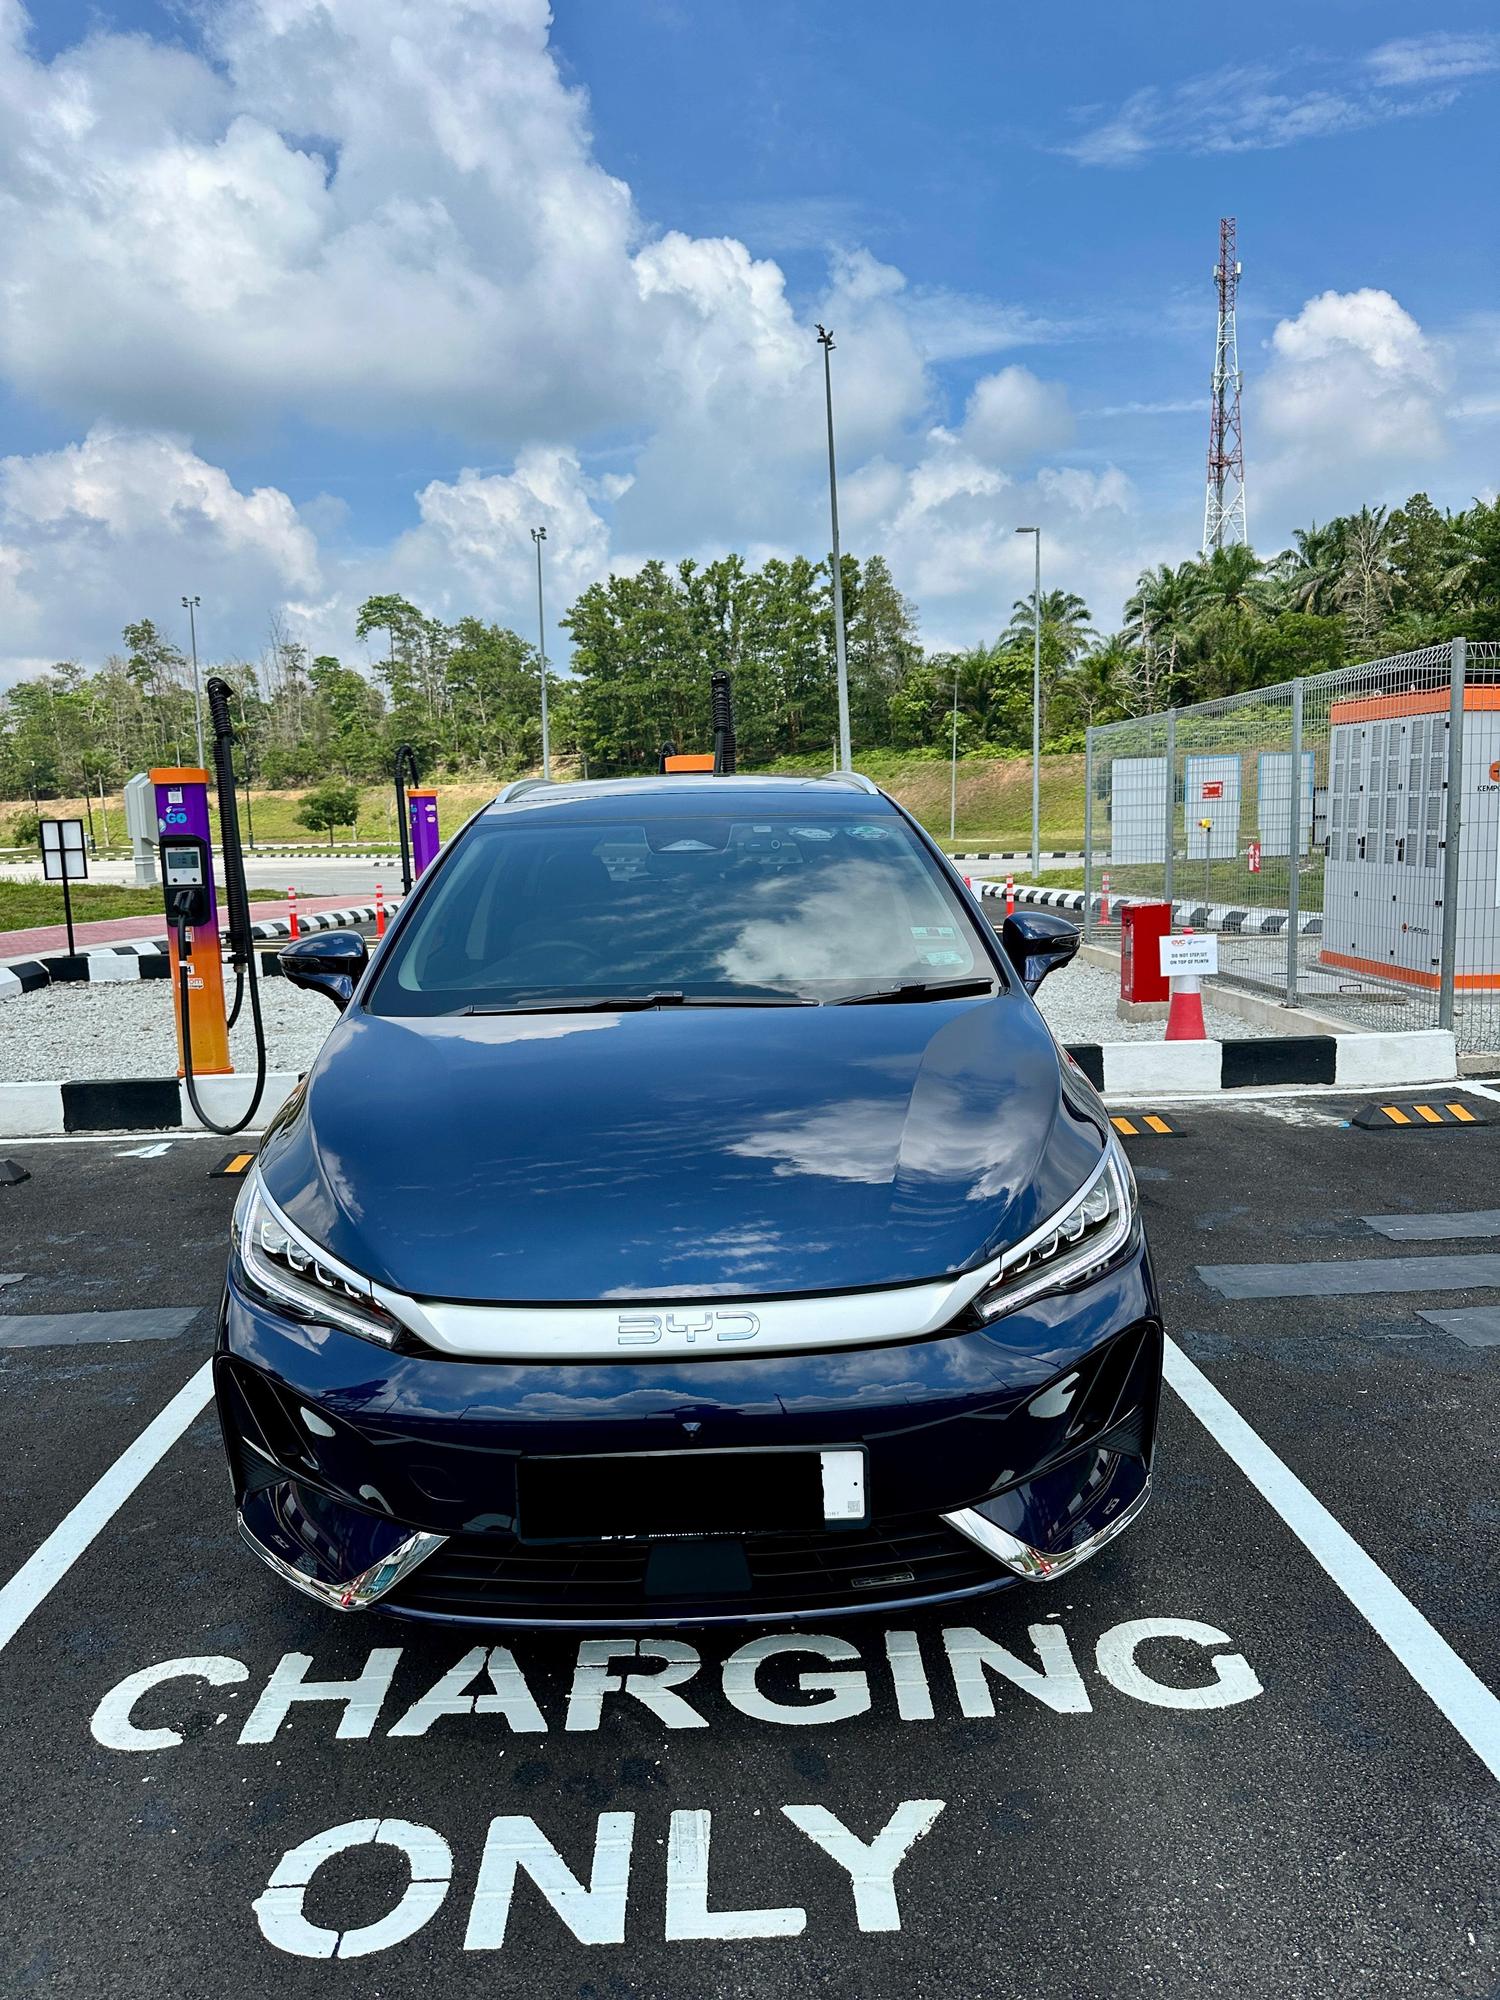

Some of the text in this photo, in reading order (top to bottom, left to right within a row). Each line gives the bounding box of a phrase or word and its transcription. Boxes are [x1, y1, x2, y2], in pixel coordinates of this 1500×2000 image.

[617, 1310, 761, 1345] BYD
[88, 1617, 1265, 1753] CHARGING
[251, 1798, 947, 1960] ONLY
